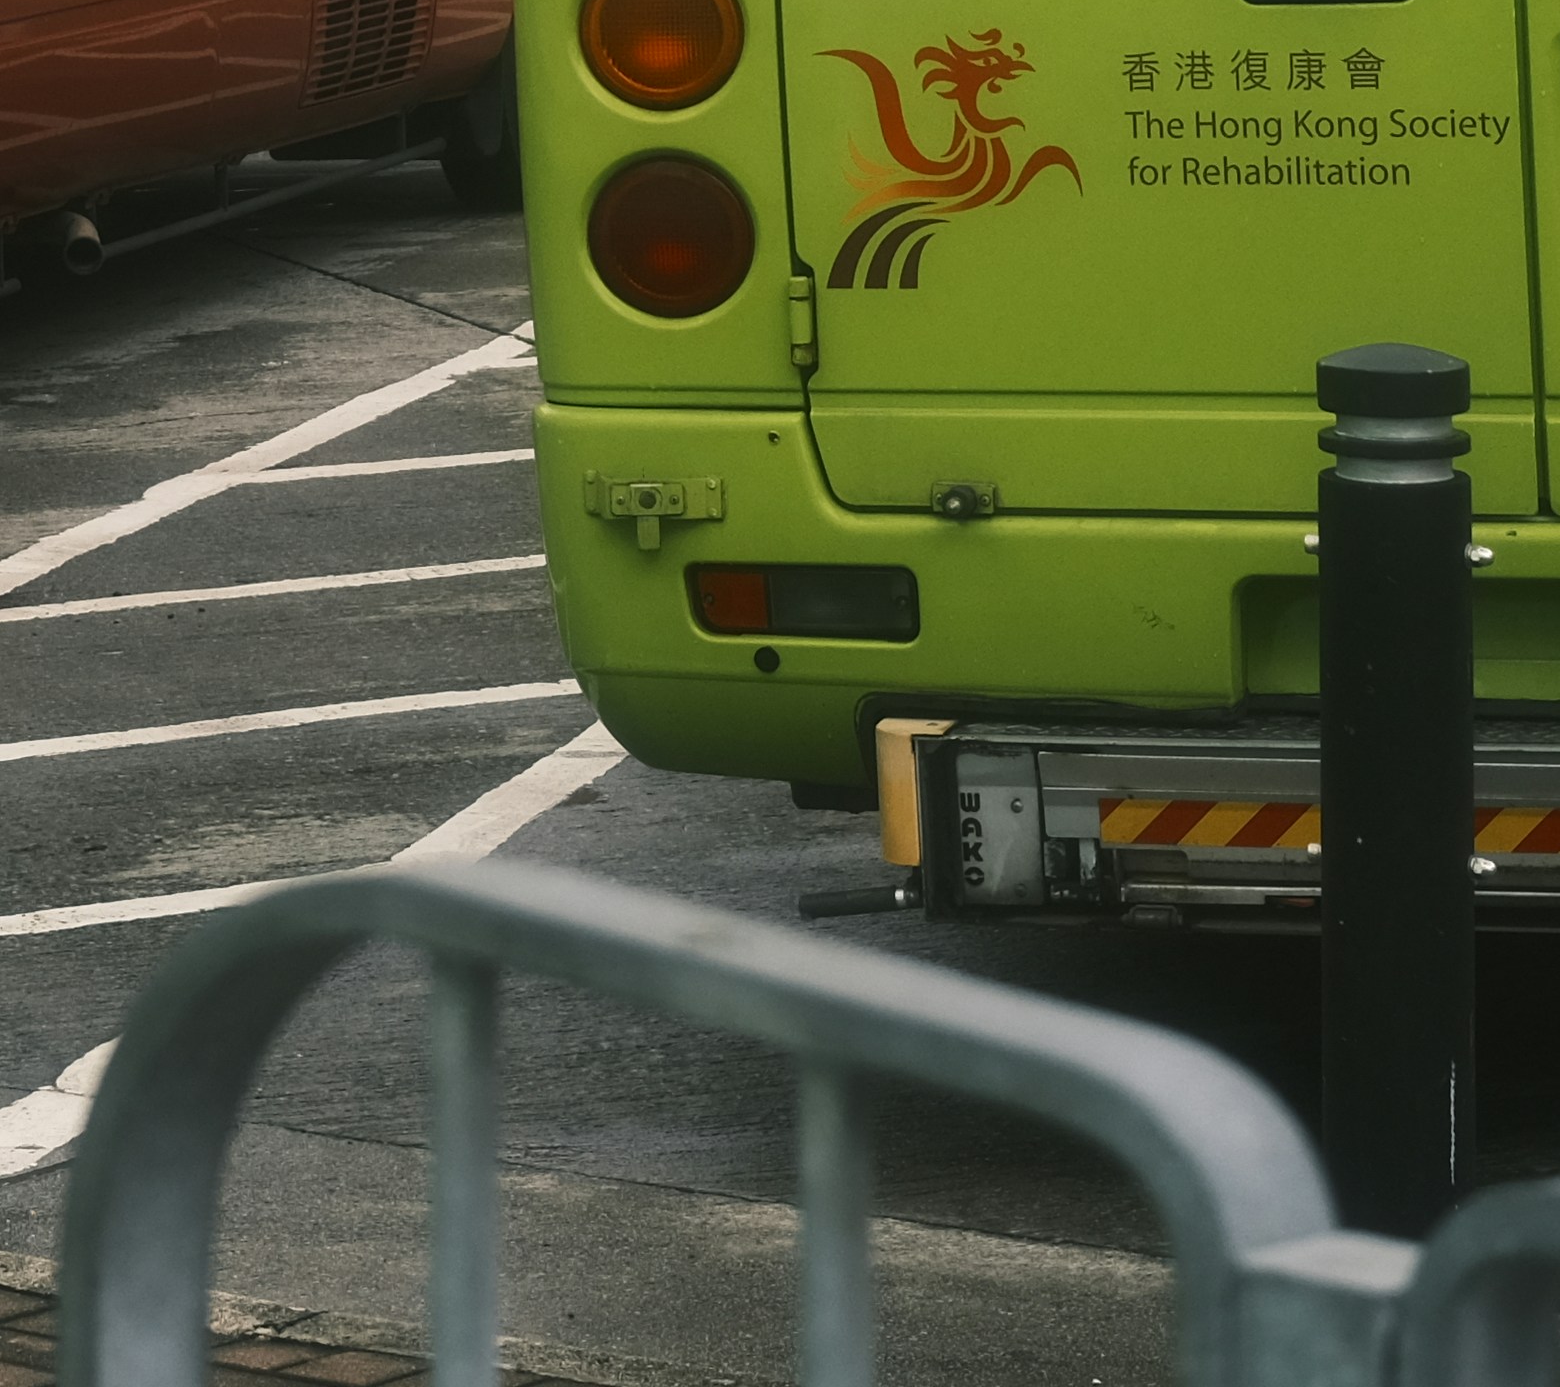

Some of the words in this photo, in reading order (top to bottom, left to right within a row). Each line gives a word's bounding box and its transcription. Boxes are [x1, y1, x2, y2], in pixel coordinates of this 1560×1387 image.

[1122, 47, 1386, 92] 香港復康會
[1124, 109, 1185, 139] The
[1195, 109, 1283, 146] Hong
[1293, 109, 1379, 146] Kong
[1389, 108, 1511, 145] Society
[1127, 156, 1172, 186] for
[1183, 155, 1411, 186] Rehabilitation
[960, 792, 985, 886] WAKO
